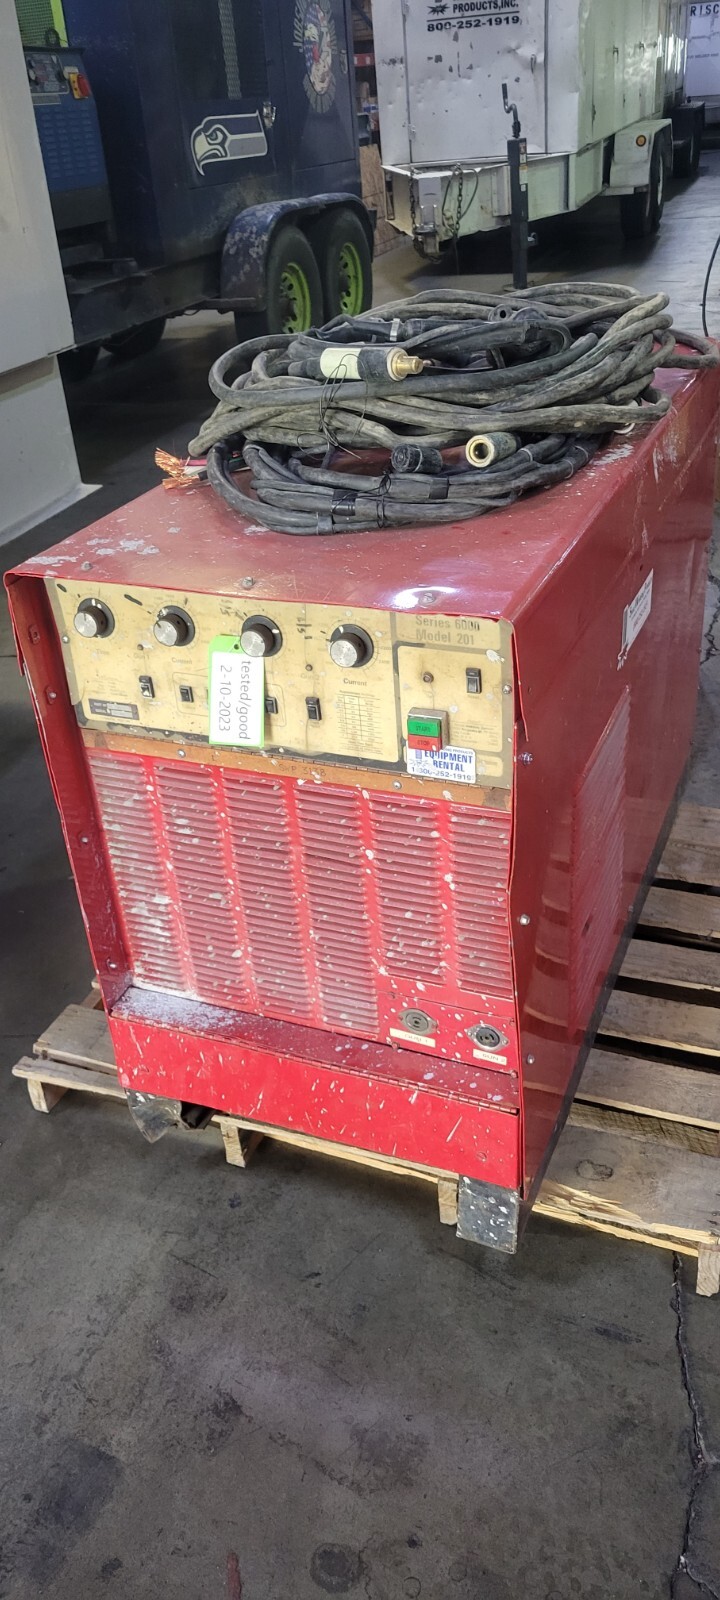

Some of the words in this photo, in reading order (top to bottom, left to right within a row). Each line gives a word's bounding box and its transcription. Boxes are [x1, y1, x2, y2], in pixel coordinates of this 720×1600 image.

[427, 16, 520, 32] 800-252-1919
[415, 616, 450, 628] Series
[455, 619, 480, 631] 6000
[415, 629, 451, 642] Model
[457, 633, 474, 645] 201
[343, 678, 367, 686] Current
[218, 665, 232, 732] 2-10-2023
[236, 661, 252, 740] tested/good
[433, 760, 465, 772] RENTAL
